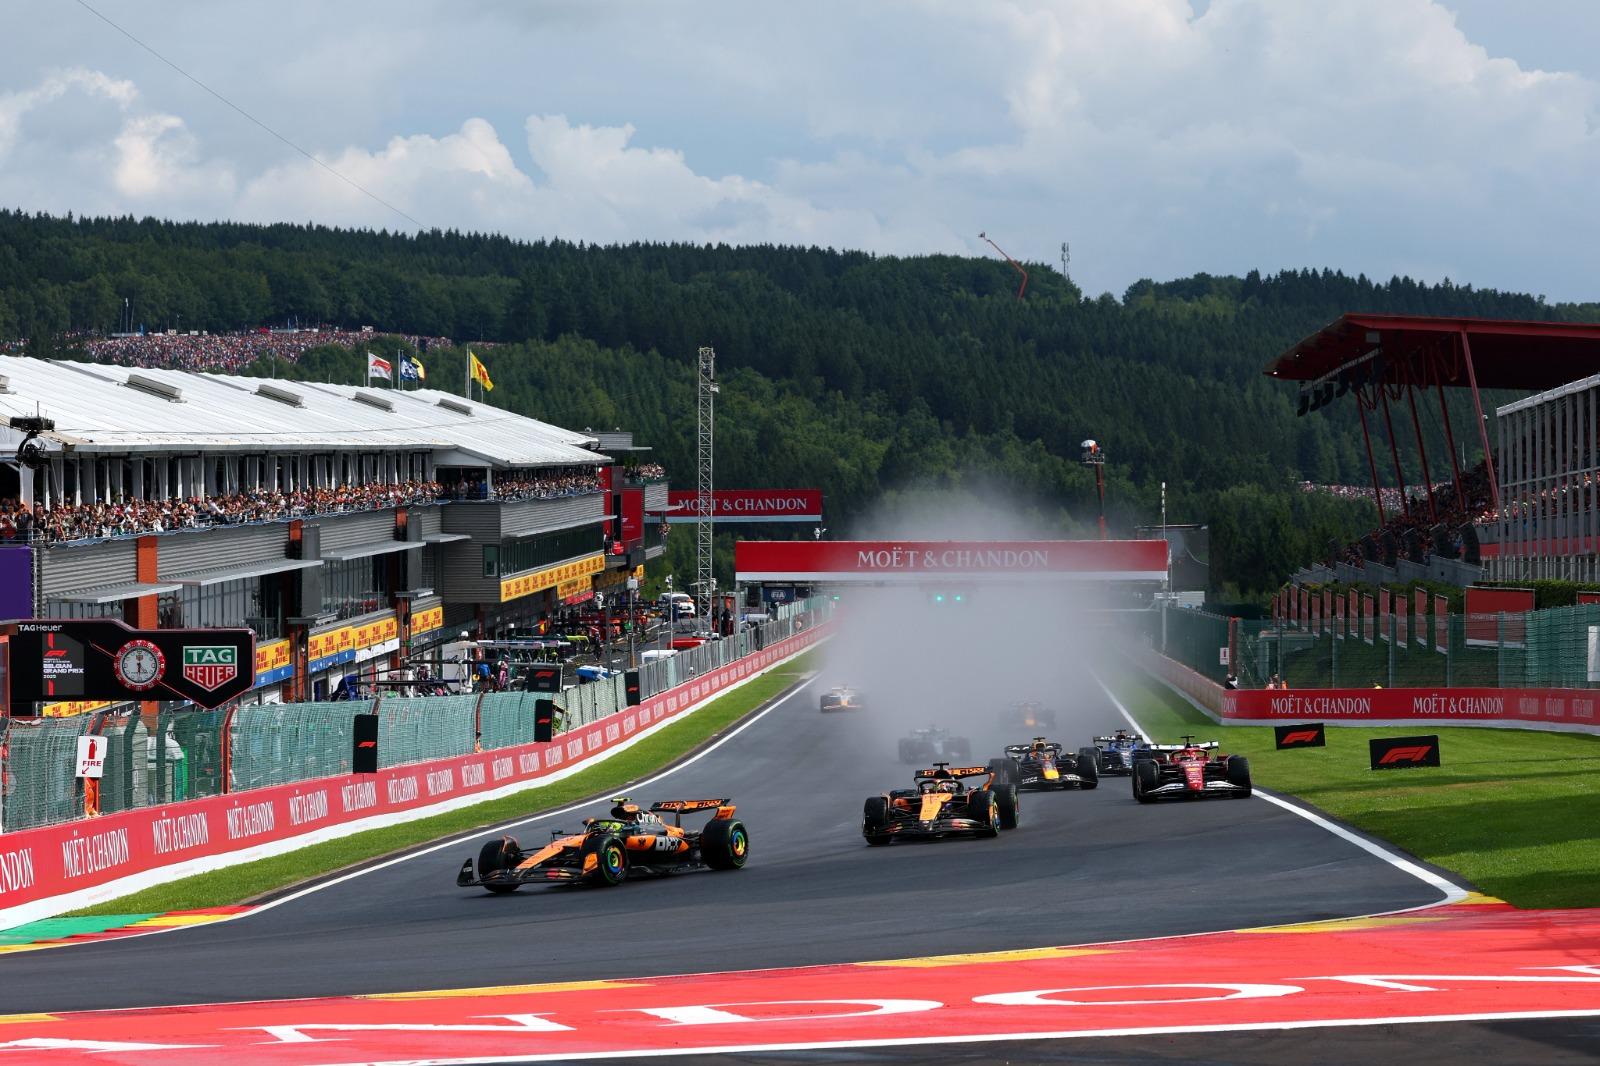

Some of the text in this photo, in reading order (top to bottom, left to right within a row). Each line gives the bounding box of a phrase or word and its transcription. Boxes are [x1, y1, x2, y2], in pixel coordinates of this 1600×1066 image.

[722, 498, 732, 511] &
[735, 498, 807, 511] CHANDON
[857, 547, 1049, 568] MOËT & CHANDON
[187, 649, 232, 663] TAG
[186, 666, 234, 688] HEUER
[1271, 694, 1371, 714] MOËT & CHANDON
[1412, 693, 1447, 714] MOËT
[1449, 697, 1458, 714] &
[1458, 697, 1504, 714] CHANDON
[226, 800, 245, 840] MOËT
[247, 801, 275, 836] CHANDON
[152, 811, 173, 855] MOËT
[177, 812, 209, 850] CHANDON
[62, 828, 129, 879] MOËT & CHANDON
